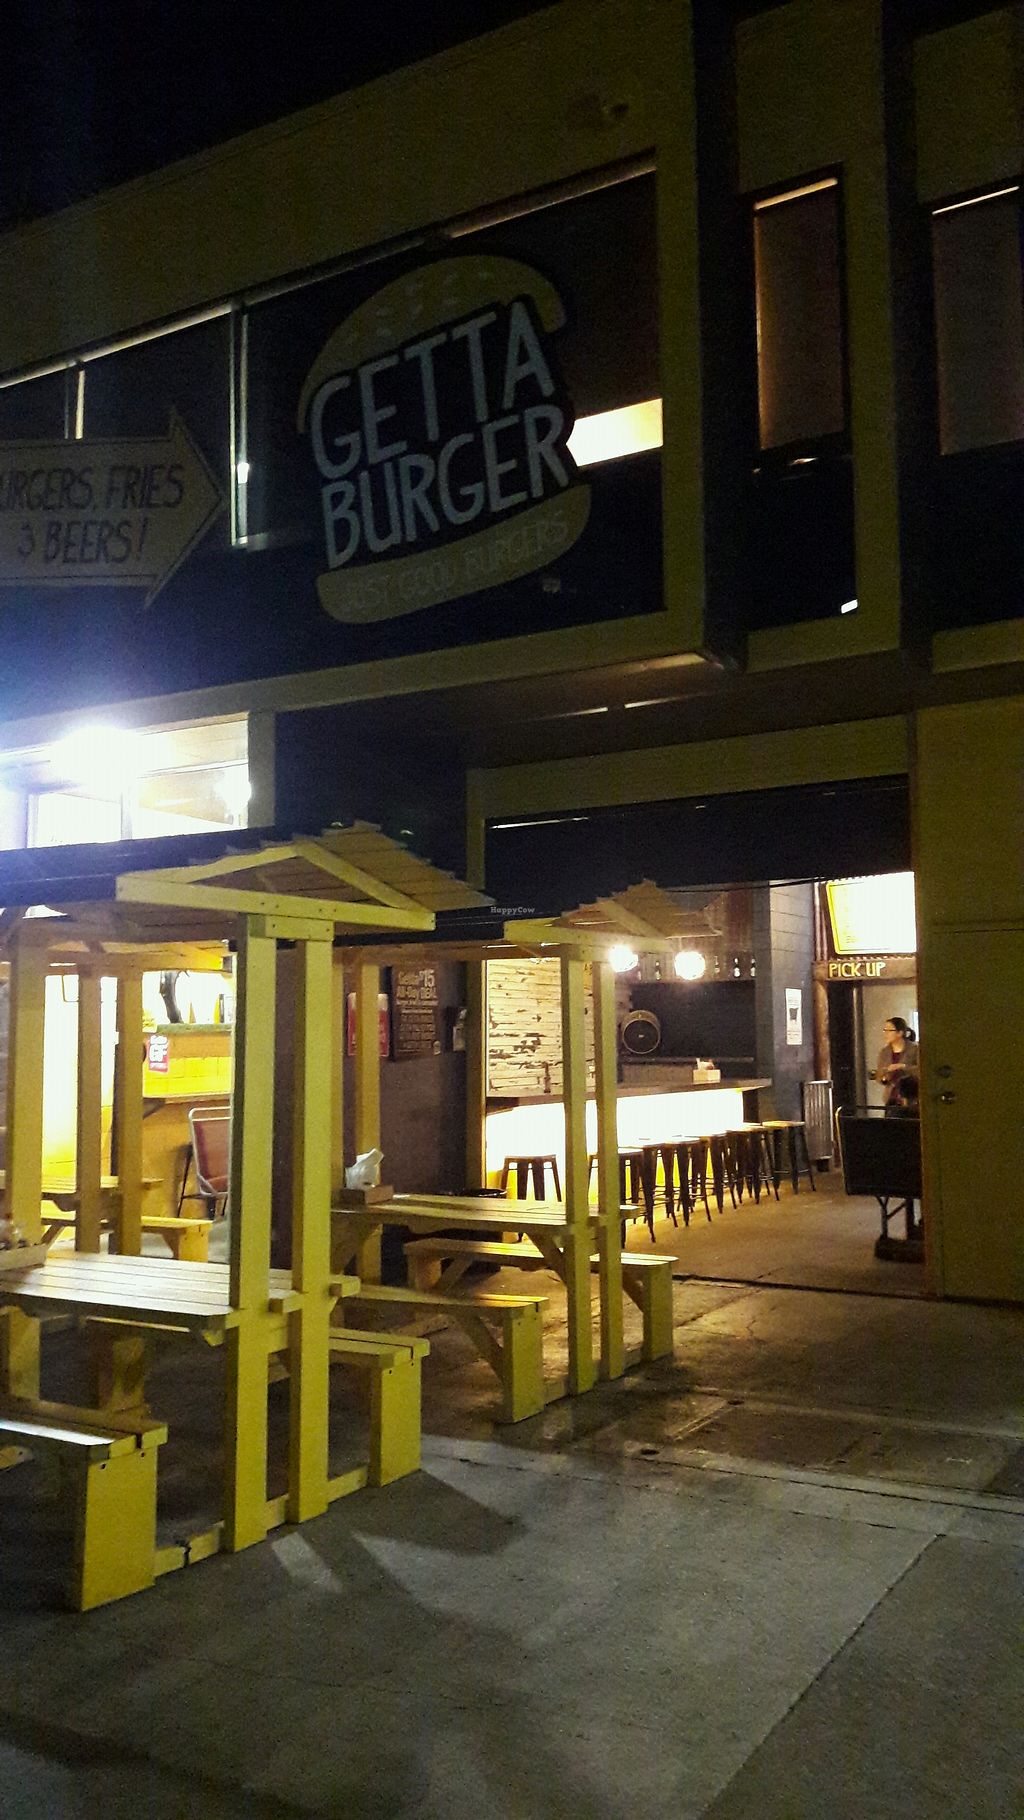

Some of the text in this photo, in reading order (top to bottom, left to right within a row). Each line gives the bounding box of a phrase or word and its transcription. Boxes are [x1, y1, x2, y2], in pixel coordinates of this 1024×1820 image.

[310, 300, 555, 480] GETTA
[104, 463, 186, 509] FRIES
[320, 402, 569, 569] BURGER
[43, 516, 148, 564] BEERS!
[464, 509, 569, 580] BURGERS
[828, 961, 886, 978] PICK UP
